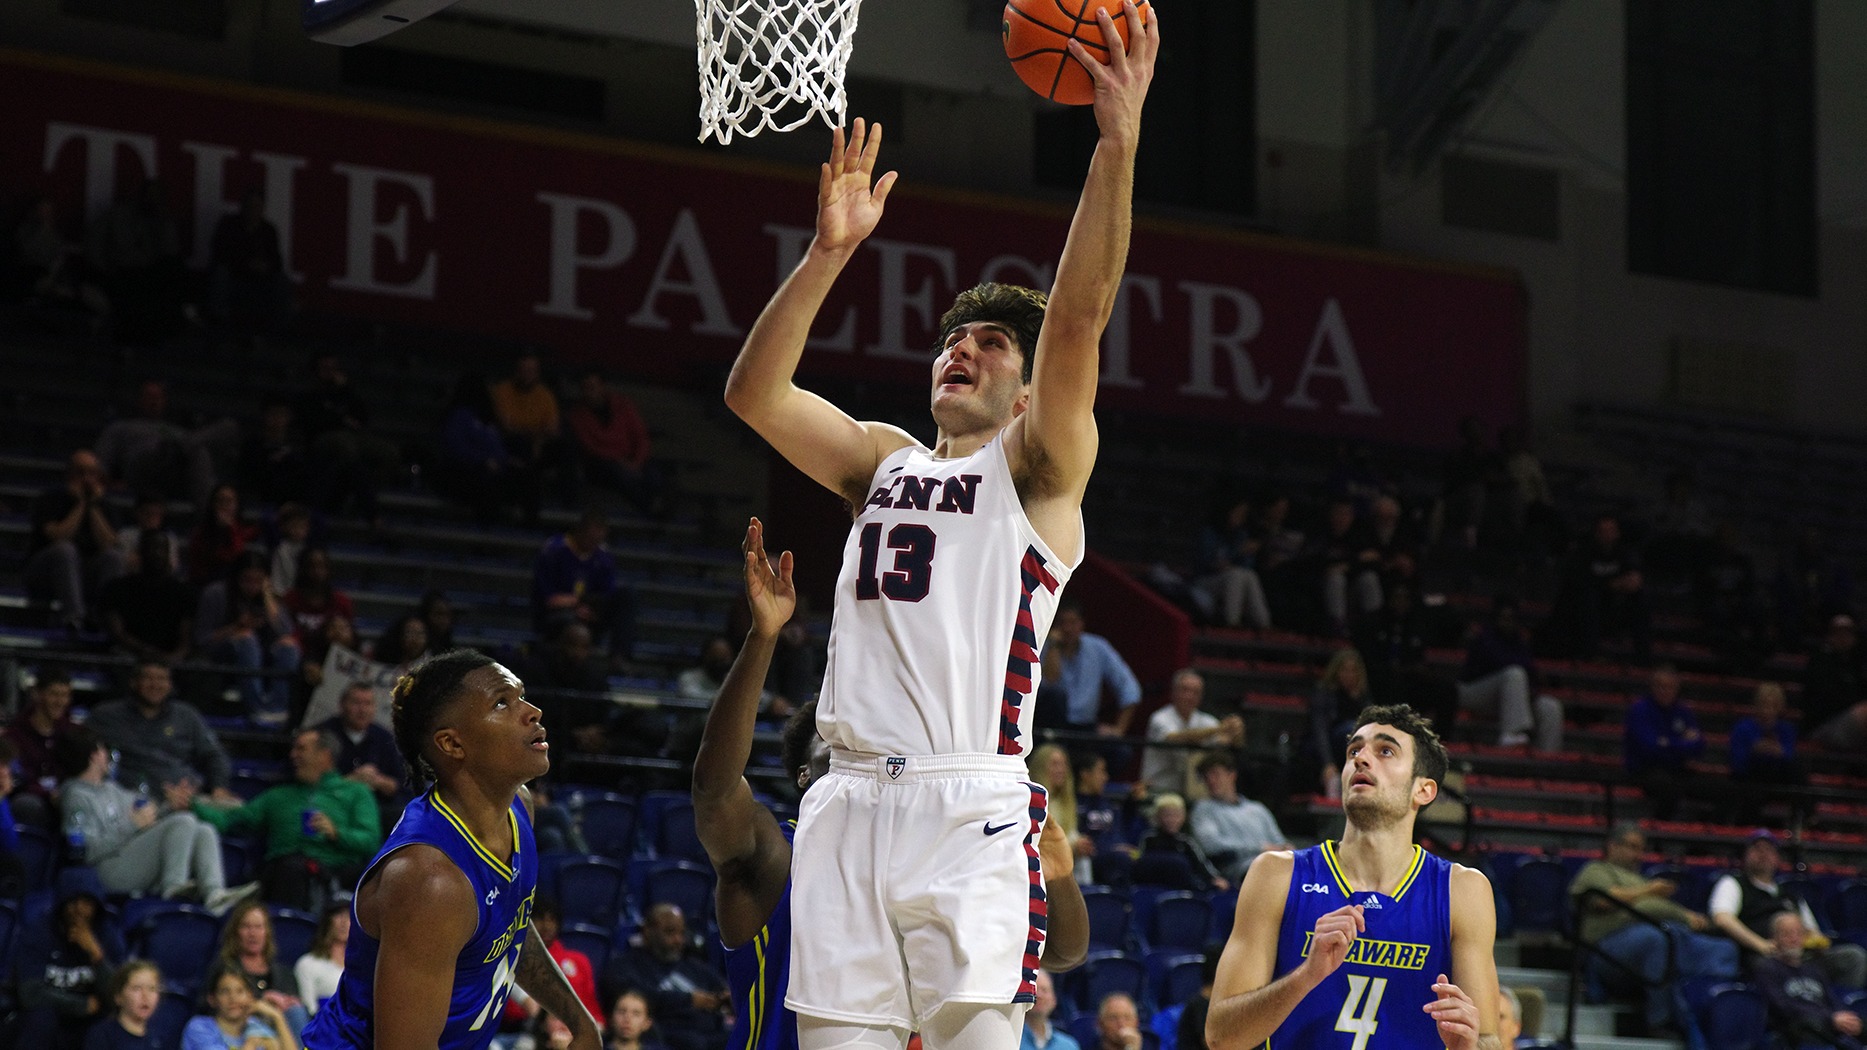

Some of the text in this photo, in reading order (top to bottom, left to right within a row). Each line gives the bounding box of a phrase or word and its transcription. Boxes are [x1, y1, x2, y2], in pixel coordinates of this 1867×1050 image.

[42, 120, 438, 299] THE
[856, 522, 937, 603] 13
[1301, 882, 1330, 895] CAA
[1301, 931, 1431, 970] AWARE
[1334, 974, 1388, 1050] 4
